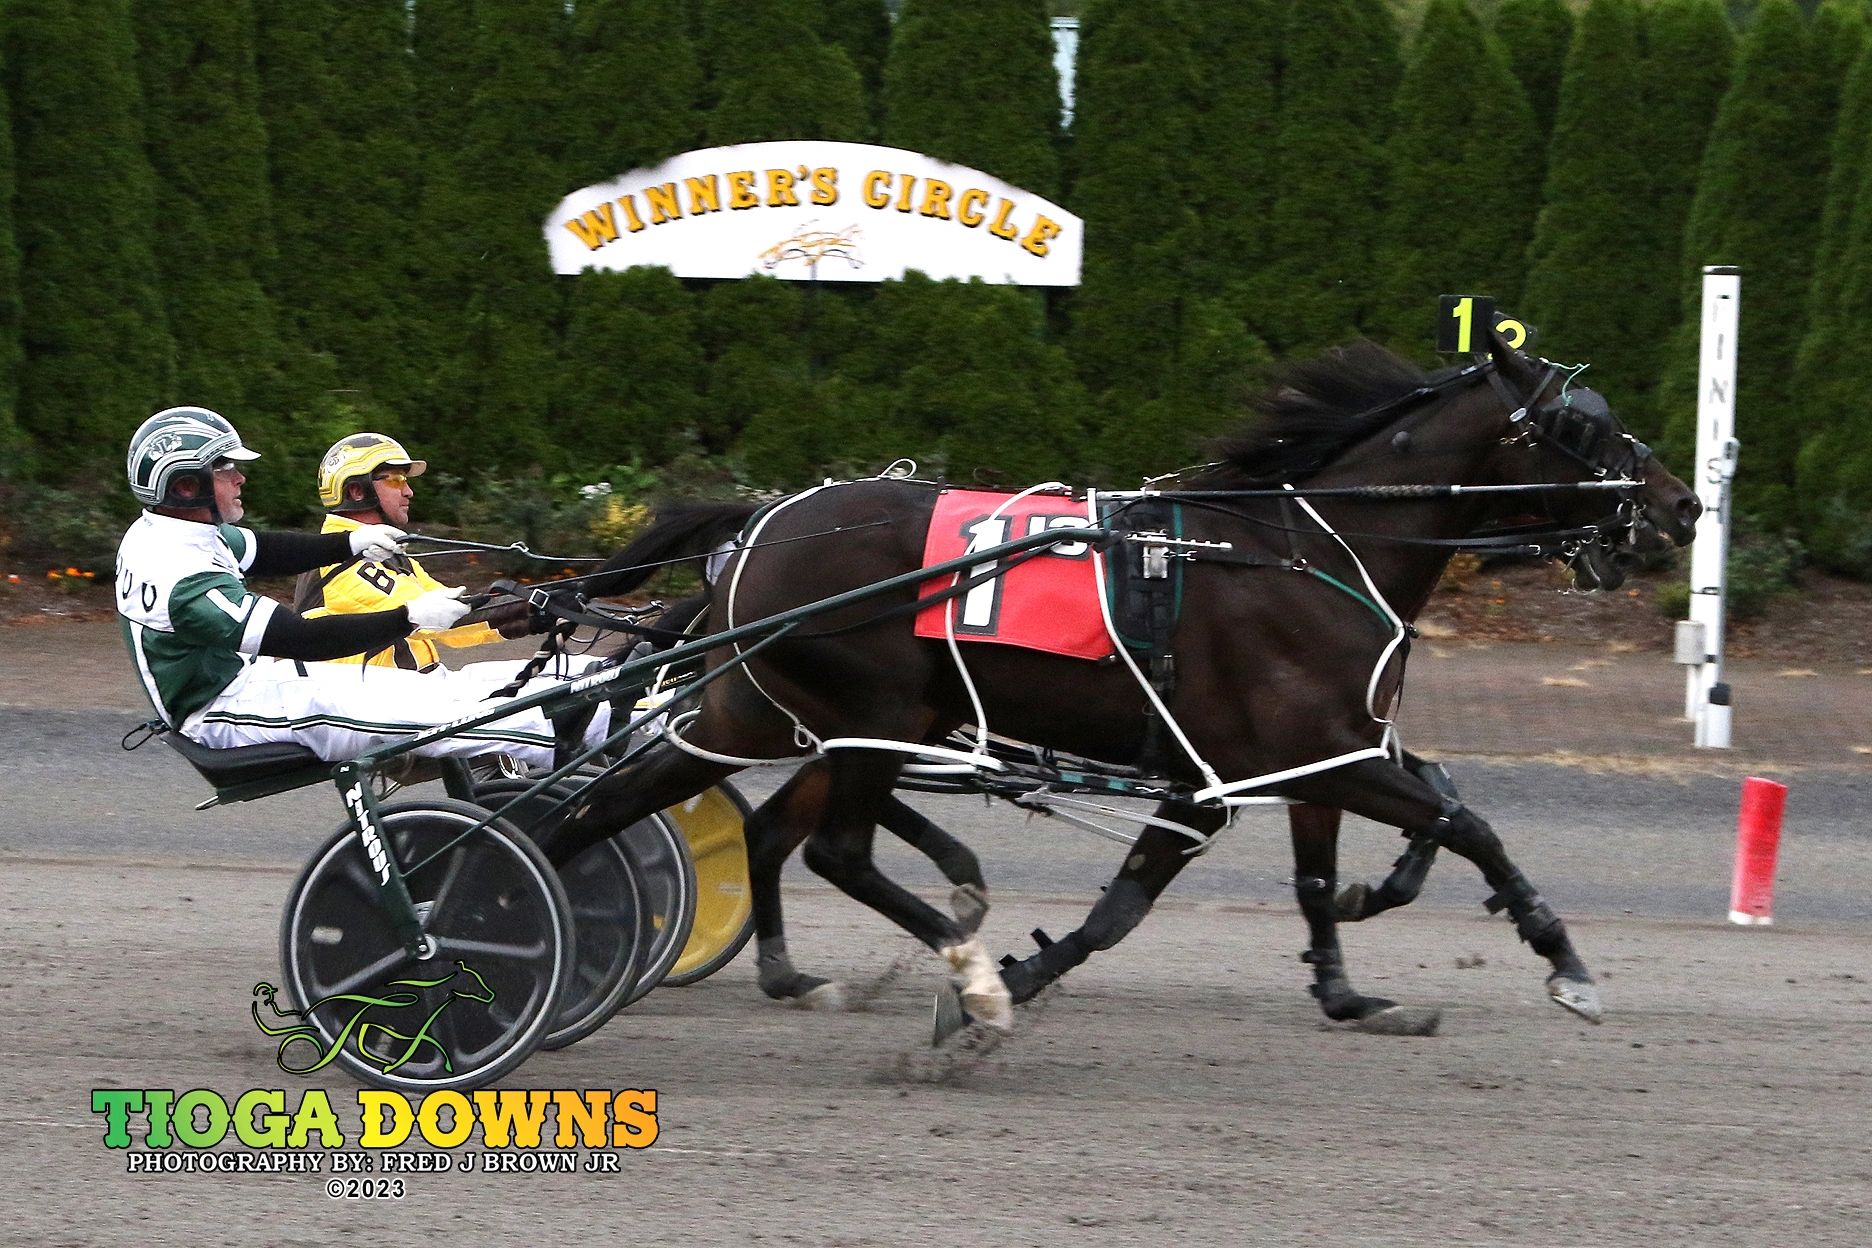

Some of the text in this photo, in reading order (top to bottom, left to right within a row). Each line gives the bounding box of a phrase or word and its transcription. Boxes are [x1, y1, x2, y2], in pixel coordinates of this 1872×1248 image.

[564, 165, 1062, 258] WINNER'S CIRCLE
[1452, 297, 1473, 353] 1
[958, 516, 1010, 632] 1
